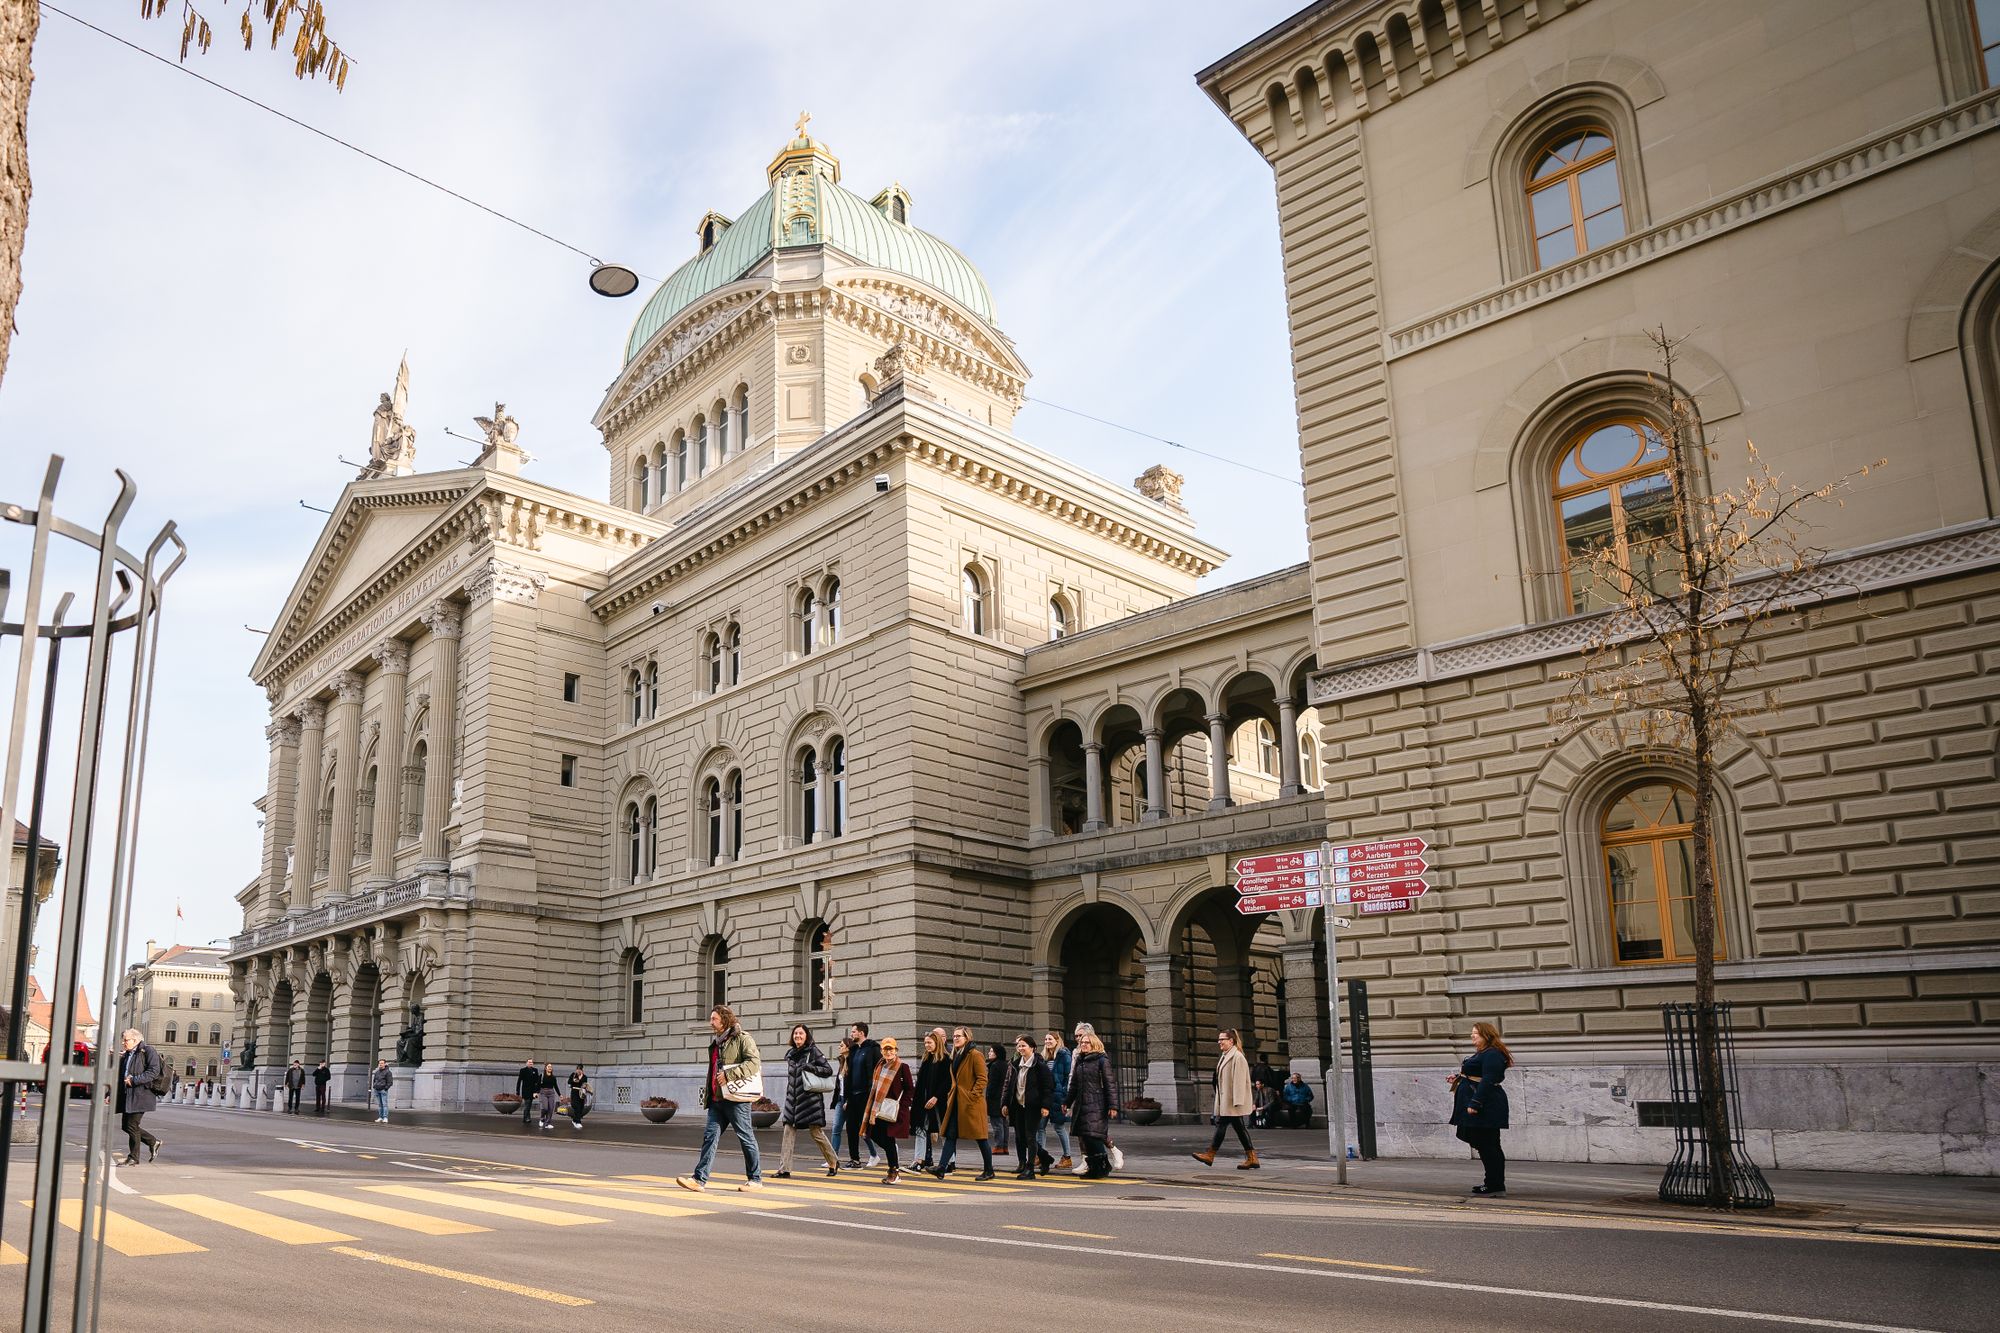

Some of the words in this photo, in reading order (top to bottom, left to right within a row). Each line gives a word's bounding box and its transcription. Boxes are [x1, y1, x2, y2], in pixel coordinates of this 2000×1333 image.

[398, 554, 459, 612] HELVETICAE
[1365, 842, 1401, 852] Biel/Bienne
[1366, 852, 1392, 860] Aarberg
[1366, 862, 1398, 871] Neuchâtel
[1243, 876, 1274, 885] Konolfingen
[1243, 884, 1268, 893] Gümligen
[1367, 884, 1390, 892] Laupen
[1364, 900, 1406, 911] Bundesgasse
